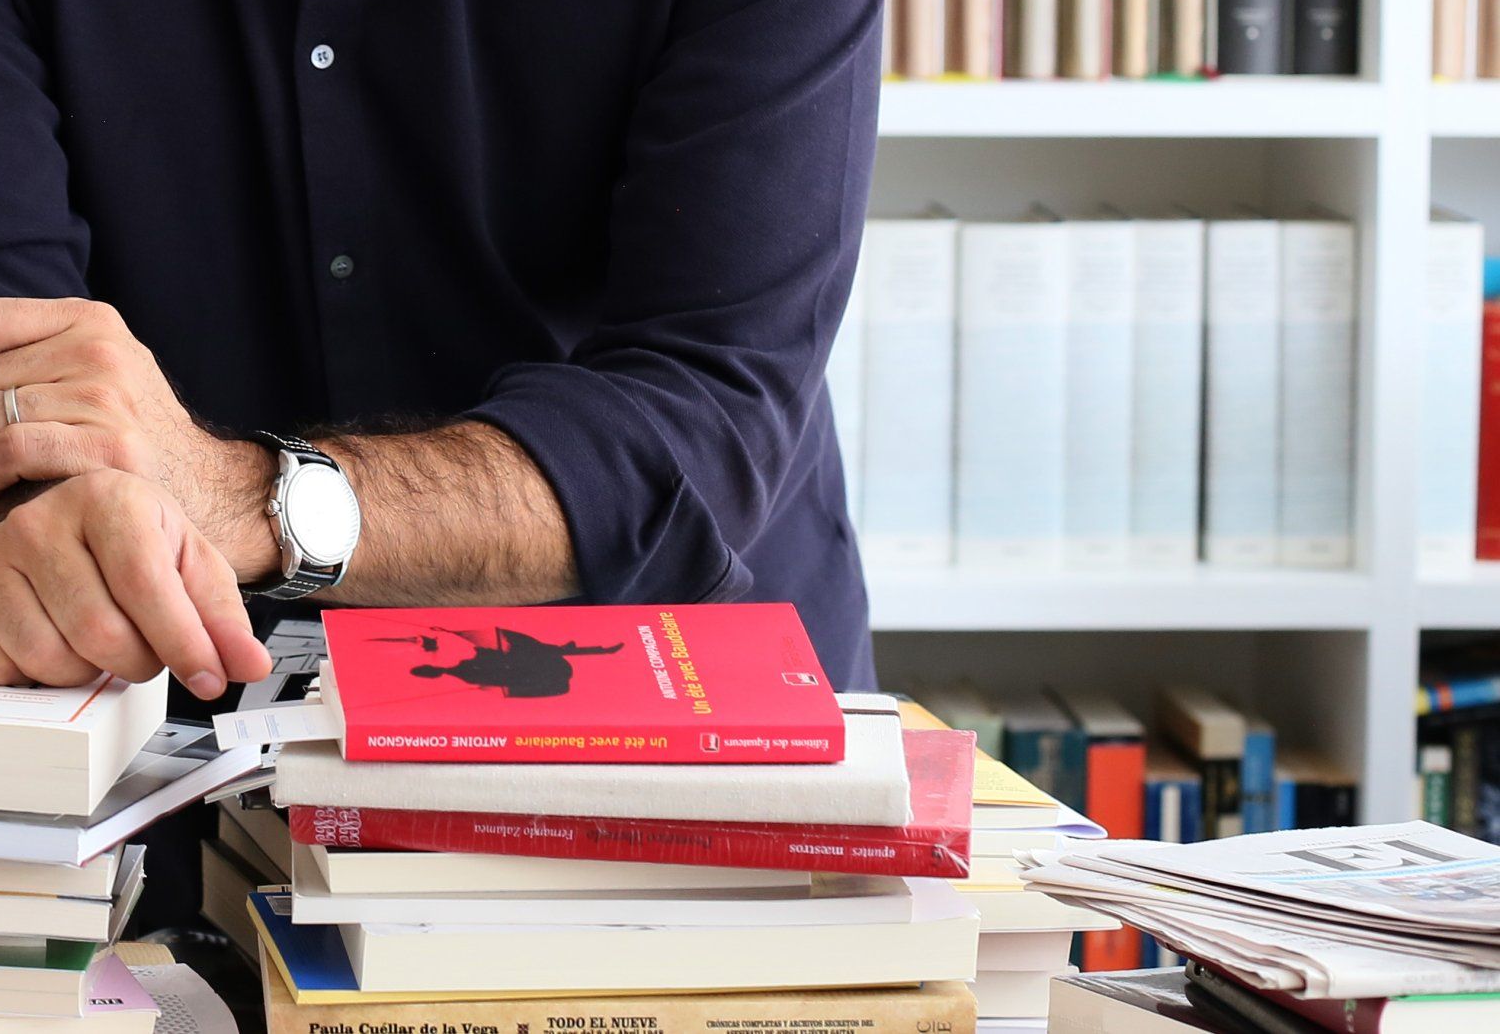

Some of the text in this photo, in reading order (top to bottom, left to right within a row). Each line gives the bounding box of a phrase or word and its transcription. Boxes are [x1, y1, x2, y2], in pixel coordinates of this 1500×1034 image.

[658, 611, 713, 715] Un été avec Baudelaire
[367, 736, 508, 748] ANTOINE COMPAGNON
[515, 736, 668, 750] Un été avec Baudelaire
[772, 739, 789, 750] des
[474, 823, 574, 840] Fernando Zalamea
[851, 846, 896, 859] apuntes
[308, 1022, 499, 1034] Paula Cuéllar de la Vega
[547, 1016, 657, 1028] TODO EL NUEVE
